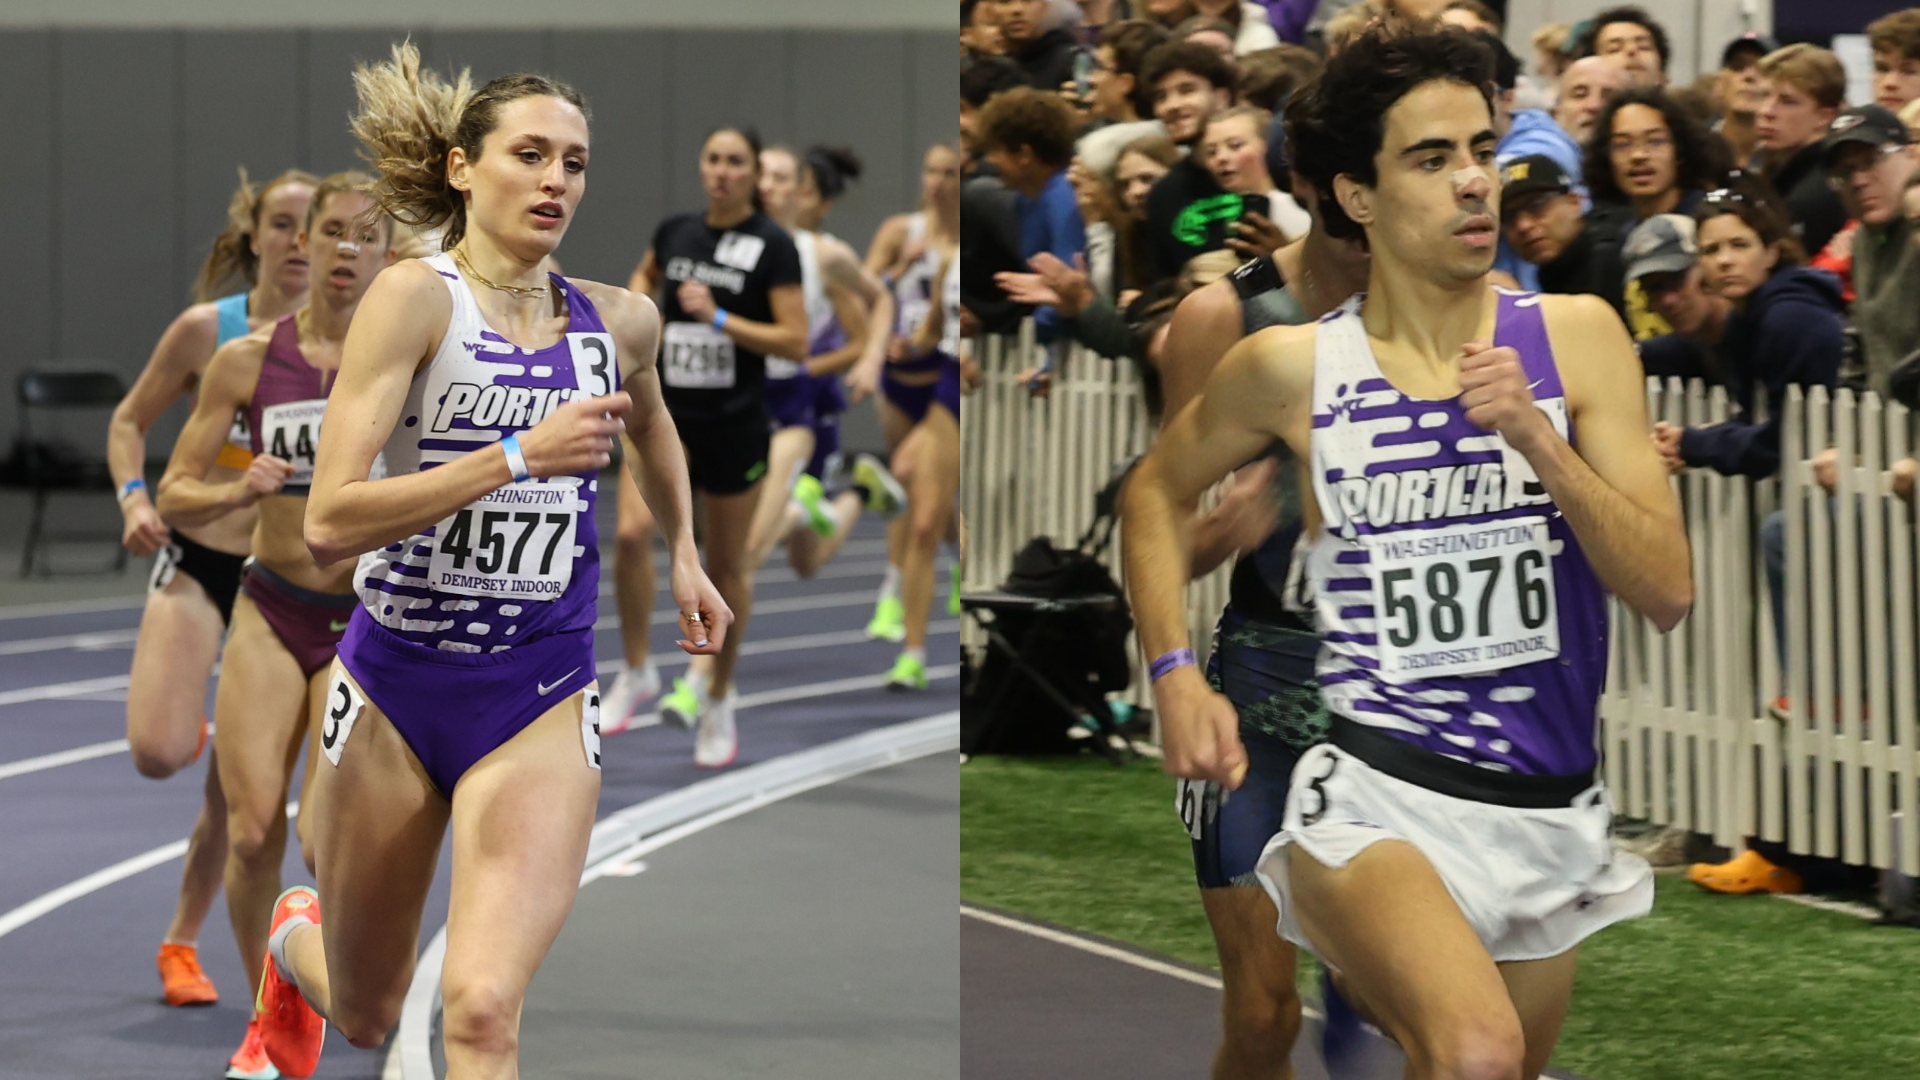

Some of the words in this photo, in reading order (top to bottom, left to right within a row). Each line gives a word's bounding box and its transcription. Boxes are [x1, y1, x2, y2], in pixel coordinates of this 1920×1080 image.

[581, 336, 609, 397] 3
[431, 382, 580, 432] PORTL
[271, 424, 322, 466] 44
[478, 489, 565, 504] SHINGTON
[440, 509, 571, 575] 4577
[1382, 524, 1536, 560] WASHINGTON
[441, 572, 508, 592] DEMPSEY
[511, 579, 562, 593] INDOOR
[1382, 549, 1548, 648] 5876
[1399, 646, 1481, 670] DEMPSEY
[323, 682, 351, 749] 3
[1300, 750, 1338, 826] 3
